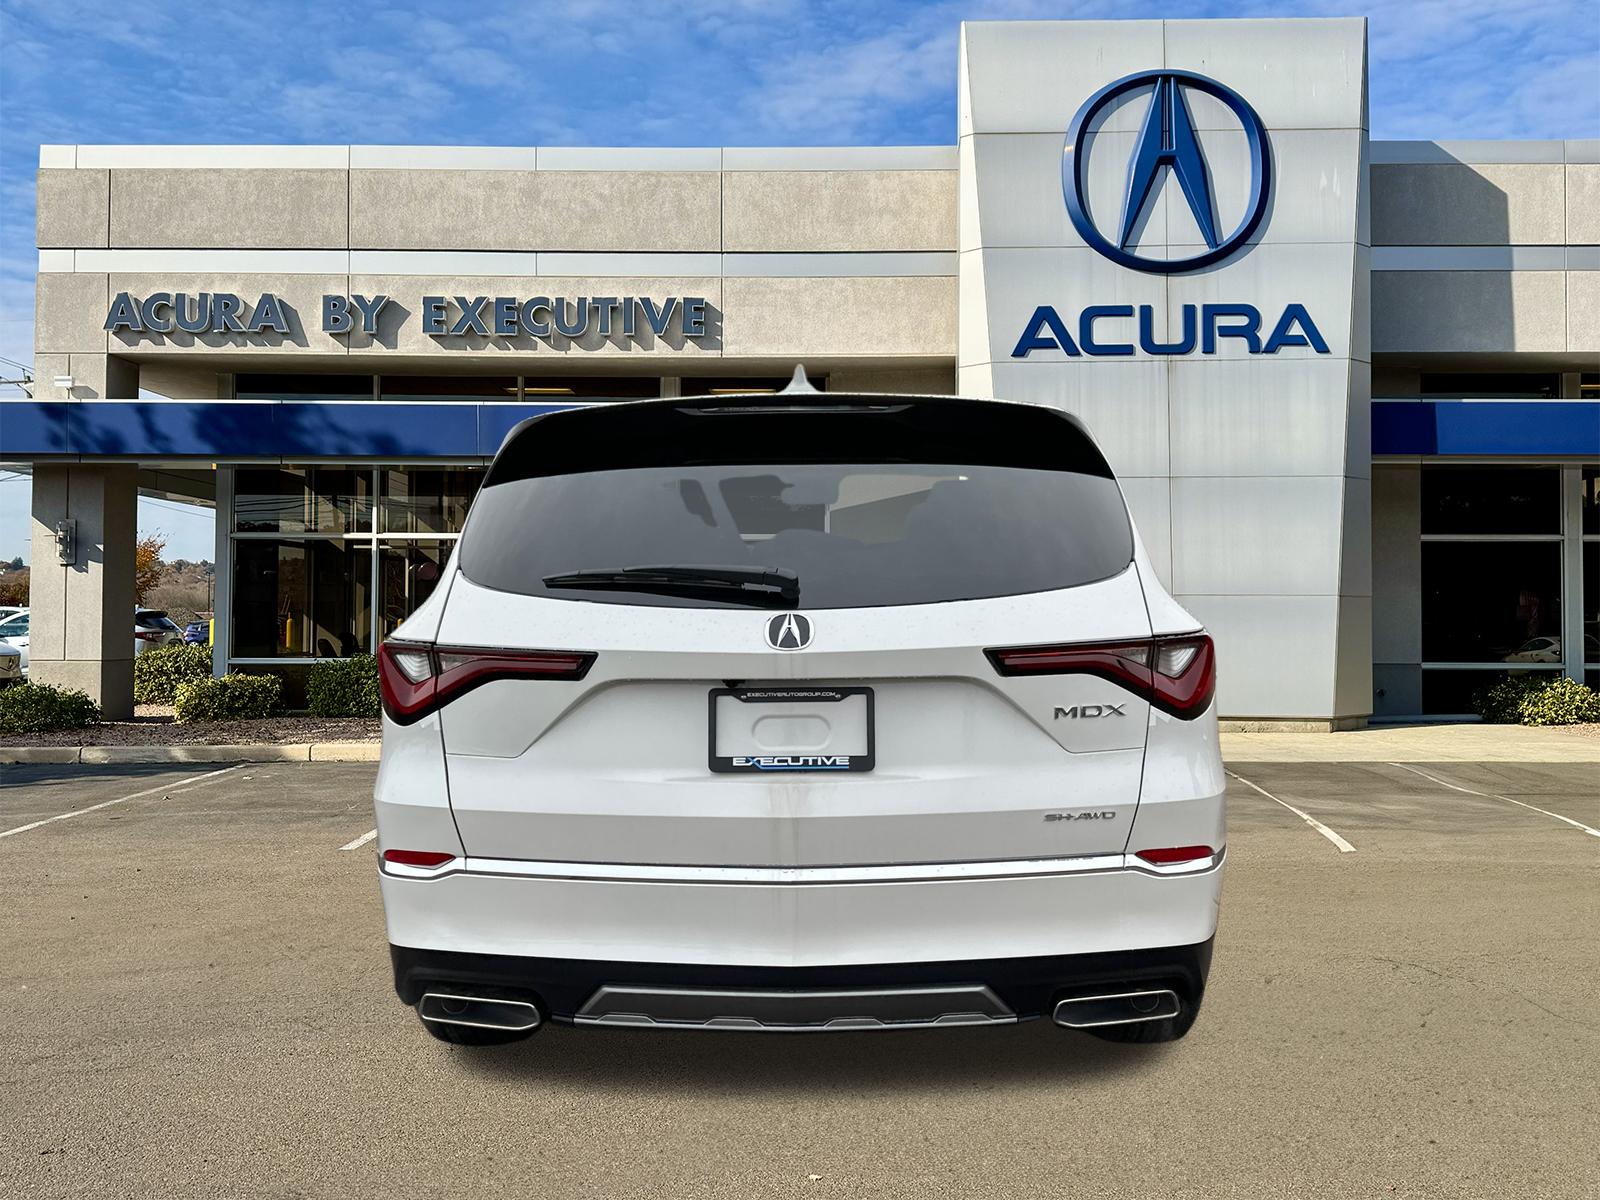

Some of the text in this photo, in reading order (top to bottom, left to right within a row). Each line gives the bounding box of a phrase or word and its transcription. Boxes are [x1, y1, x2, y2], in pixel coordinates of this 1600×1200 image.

[103, 291, 706, 336] ACURA BY EXECUTIVE
[1010, 303, 1332, 357] ACURA
[1053, 703, 1127, 720] MDX
[732, 756, 850, 767] EXECUTIVE
